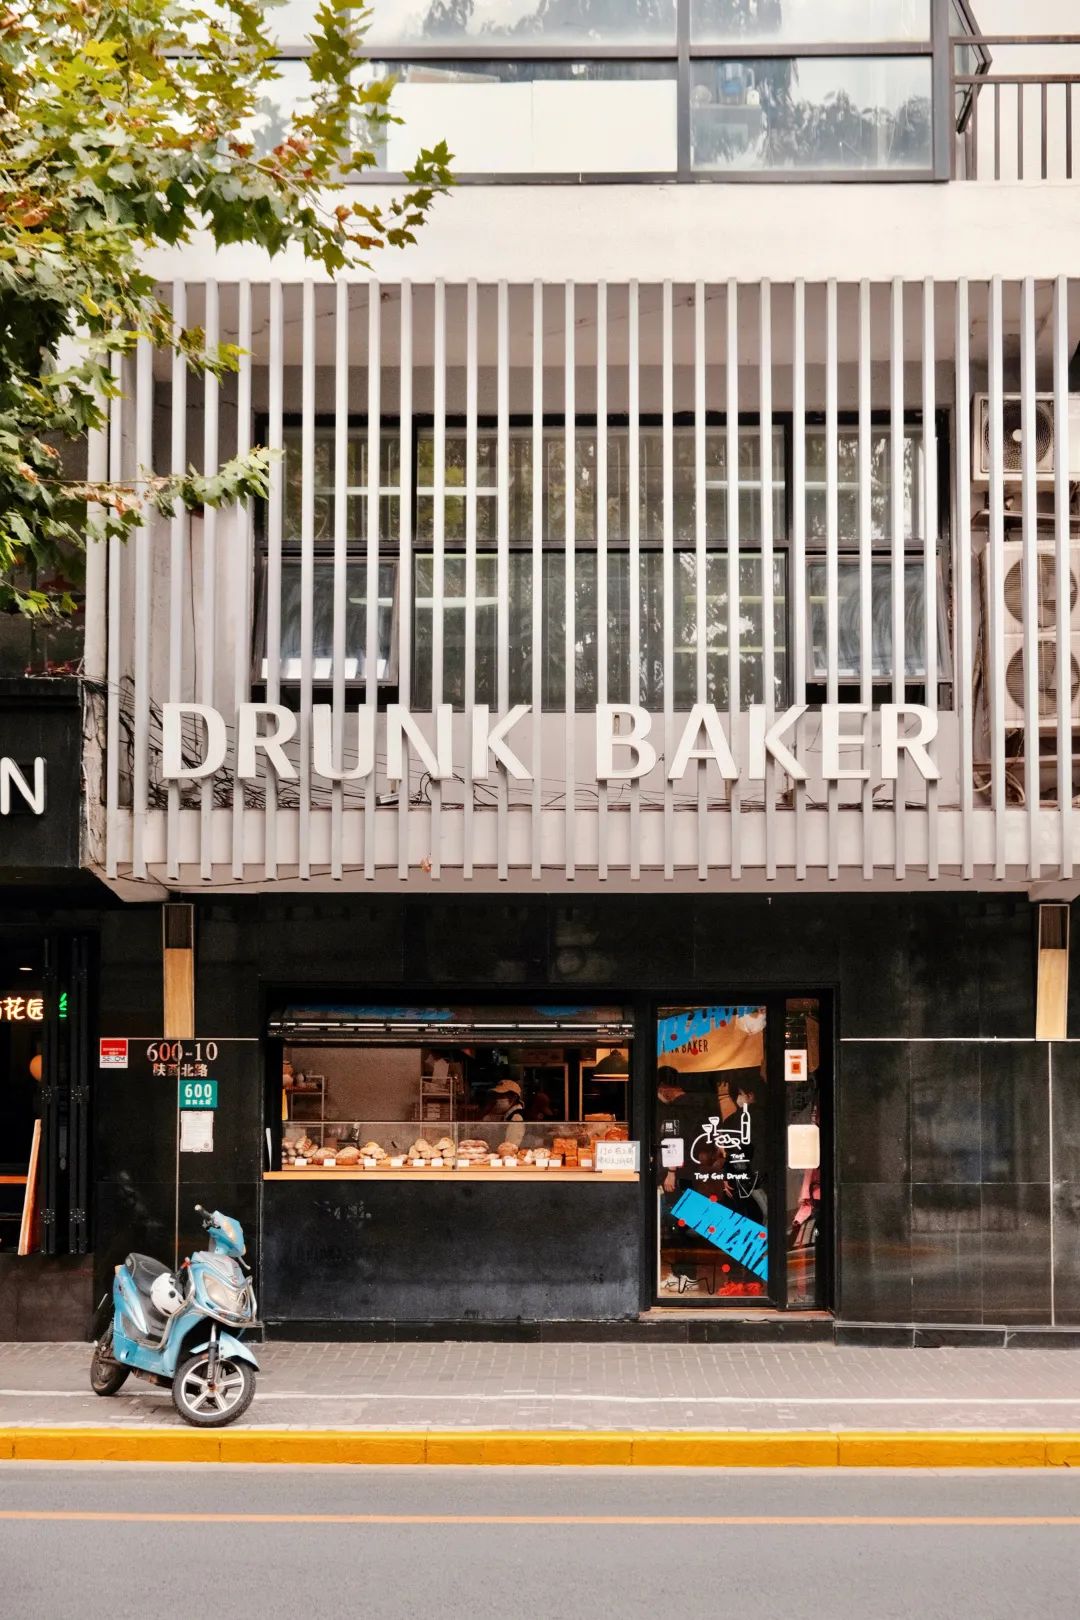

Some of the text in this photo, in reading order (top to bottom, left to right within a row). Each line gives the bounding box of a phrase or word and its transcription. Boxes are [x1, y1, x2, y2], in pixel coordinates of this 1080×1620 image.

[162, 702, 942, 781] DRUNK BAKER
[0, 756, 47, 815] N
[0, 996, 44, 1020] 花园
[146, 1042, 218, 1062] 600-10
[184, 1083, 212, 1098] 600
